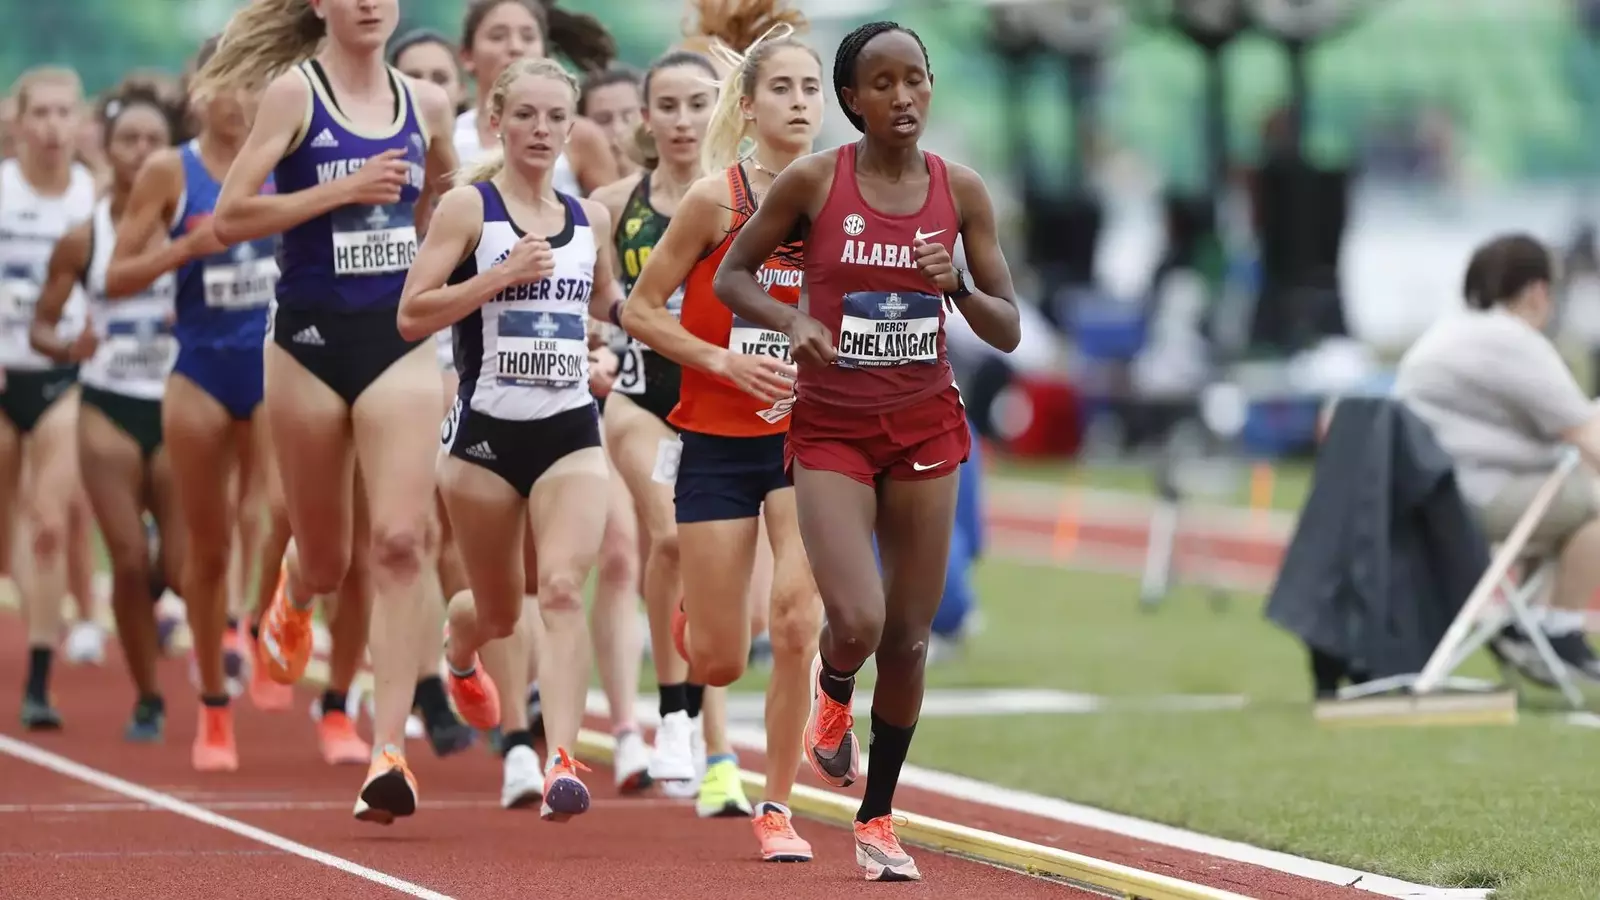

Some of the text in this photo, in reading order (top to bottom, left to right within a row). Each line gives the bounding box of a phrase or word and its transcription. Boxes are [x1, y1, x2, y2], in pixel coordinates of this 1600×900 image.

[844, 214, 864, 235] SEC
[337, 240, 416, 269] HERBERG
[840, 239, 918, 269] ALABA
[489, 277, 592, 303] EBER STAT
[755, 263, 804, 292] Syrac
[759, 332, 790, 343] AMAN
[875, 322, 908, 333] MERCY
[534, 340, 558, 351] LEXIE
[741, 342, 791, 362] VEST
[840, 330, 937, 357] CHELANGAT
[498, 351, 583, 377] THOMPSON
